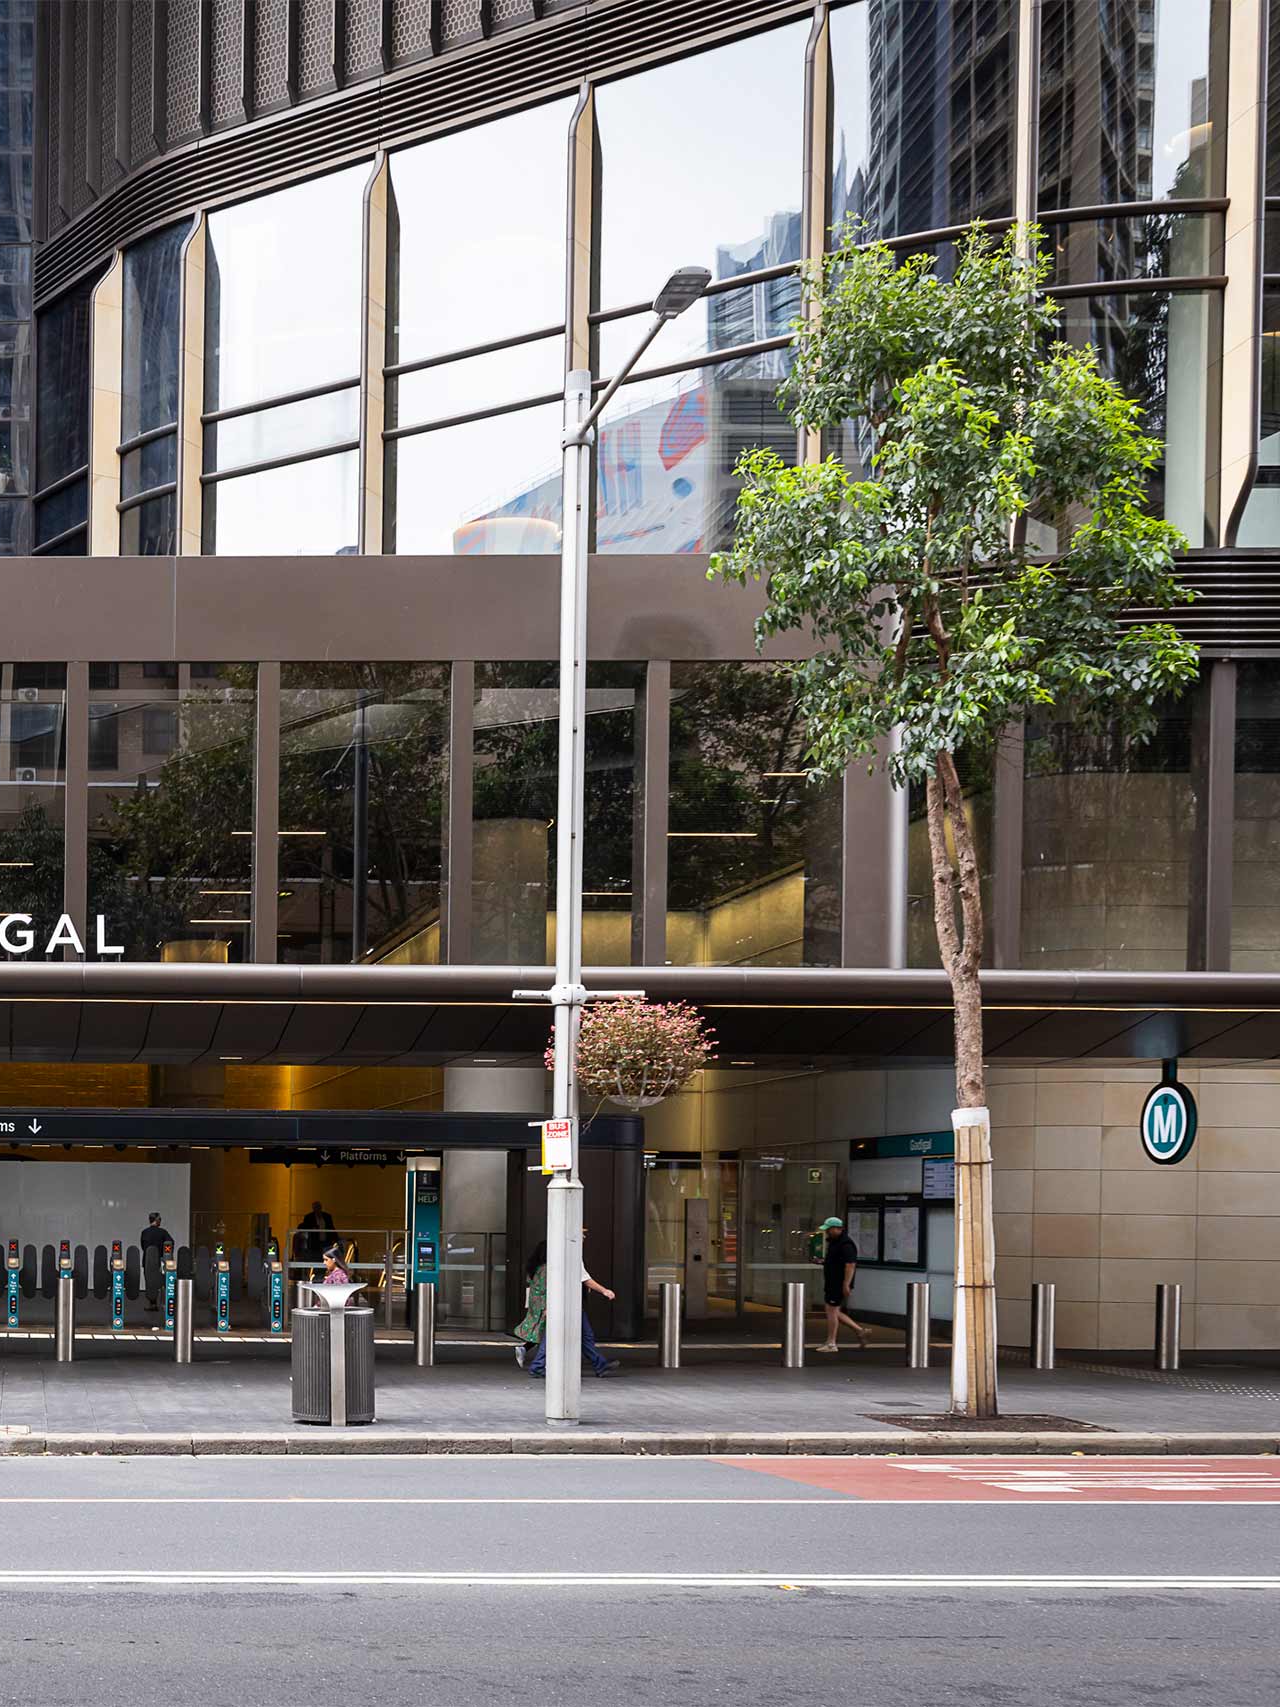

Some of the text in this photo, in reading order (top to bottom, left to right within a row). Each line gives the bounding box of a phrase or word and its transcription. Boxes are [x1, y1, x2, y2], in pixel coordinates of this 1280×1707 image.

[1153, 1104, 1177, 1144] M
[340, 1151, 387, 1161] Platforms
[417, 1195, 438, 1203] HELP
